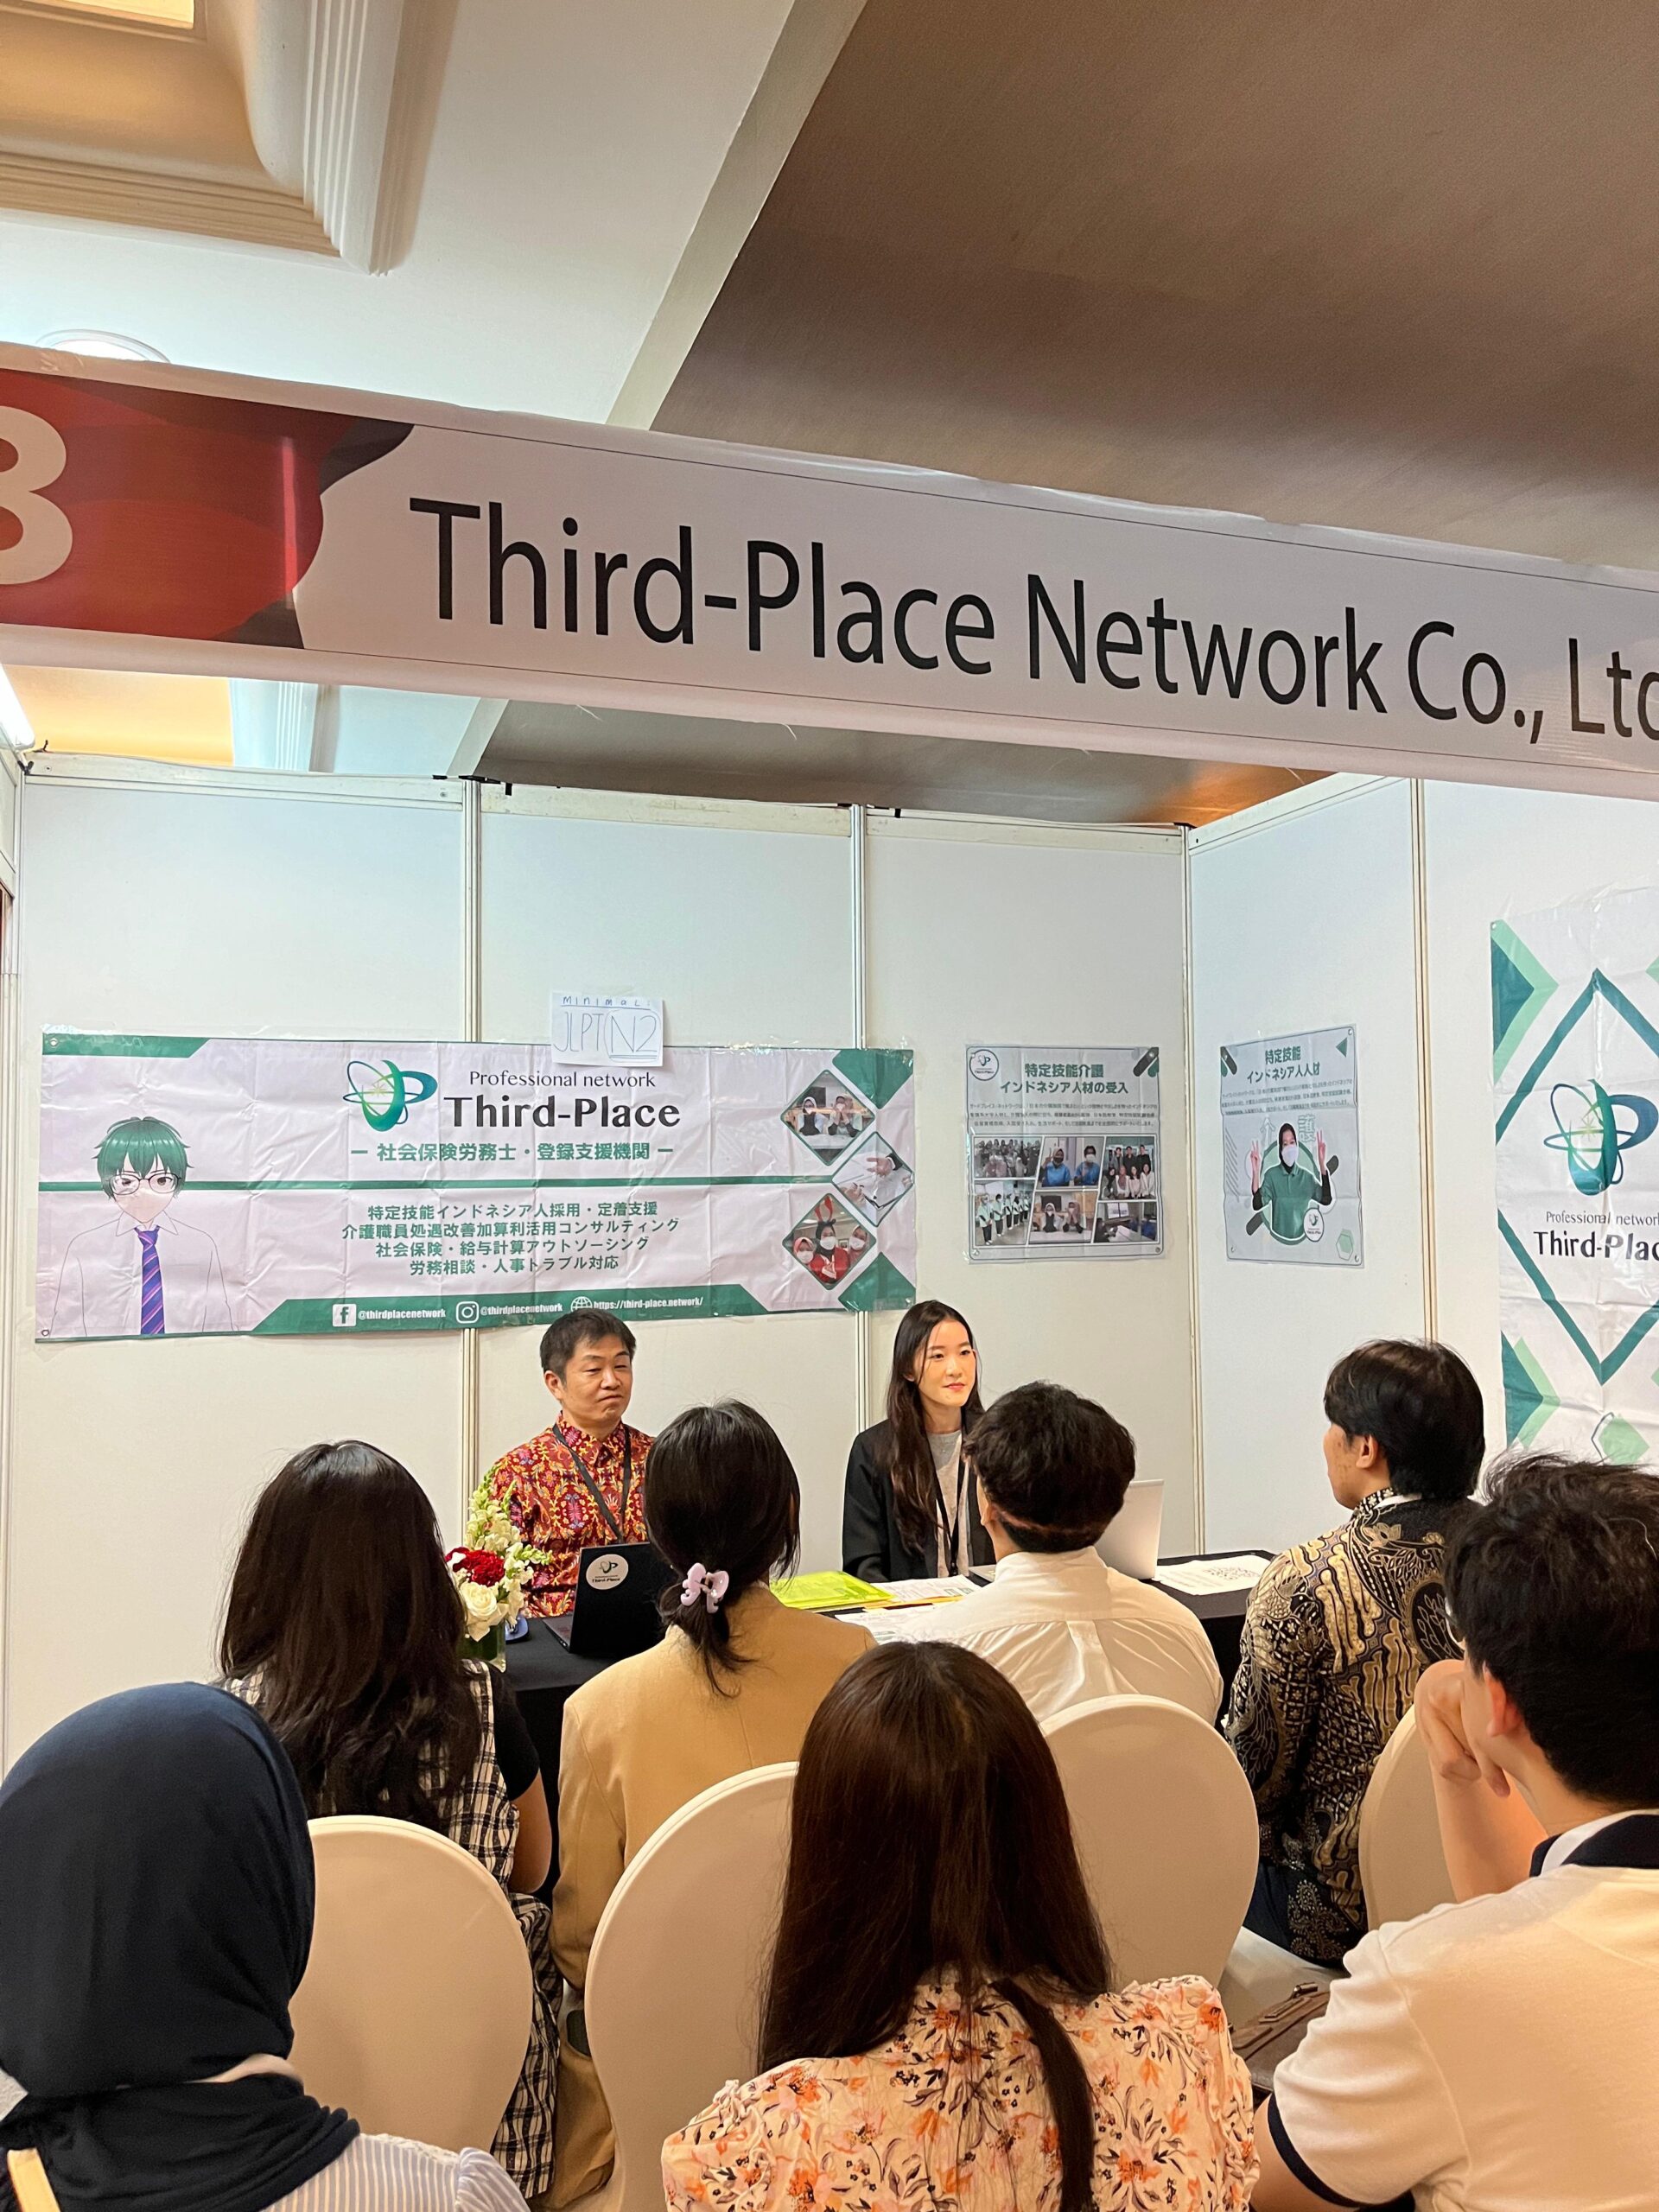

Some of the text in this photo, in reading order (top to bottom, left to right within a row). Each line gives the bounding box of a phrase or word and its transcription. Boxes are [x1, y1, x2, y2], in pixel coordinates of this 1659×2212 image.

[410, 498, 995, 676] Third-Place
[1027, 574, 1388, 715] Network
[1408, 621, 1543, 745] Co.,
[553, 1011, 657, 1052] JLPT N2
[1265, 1046, 1301, 1065] 特定技能
[470, 1071, 656, 1087] Professional network
[1025, 1064, 1104, 1078] 特定技能介護
[1000, 1081, 1128, 1094] インドネシア人材の受入
[443, 1095, 680, 1128] Third-Place
[1546, 1211, 1659, 1225] Professional networ
[410, 1255, 620, 1275] 労務相談・人事トラブル対応
